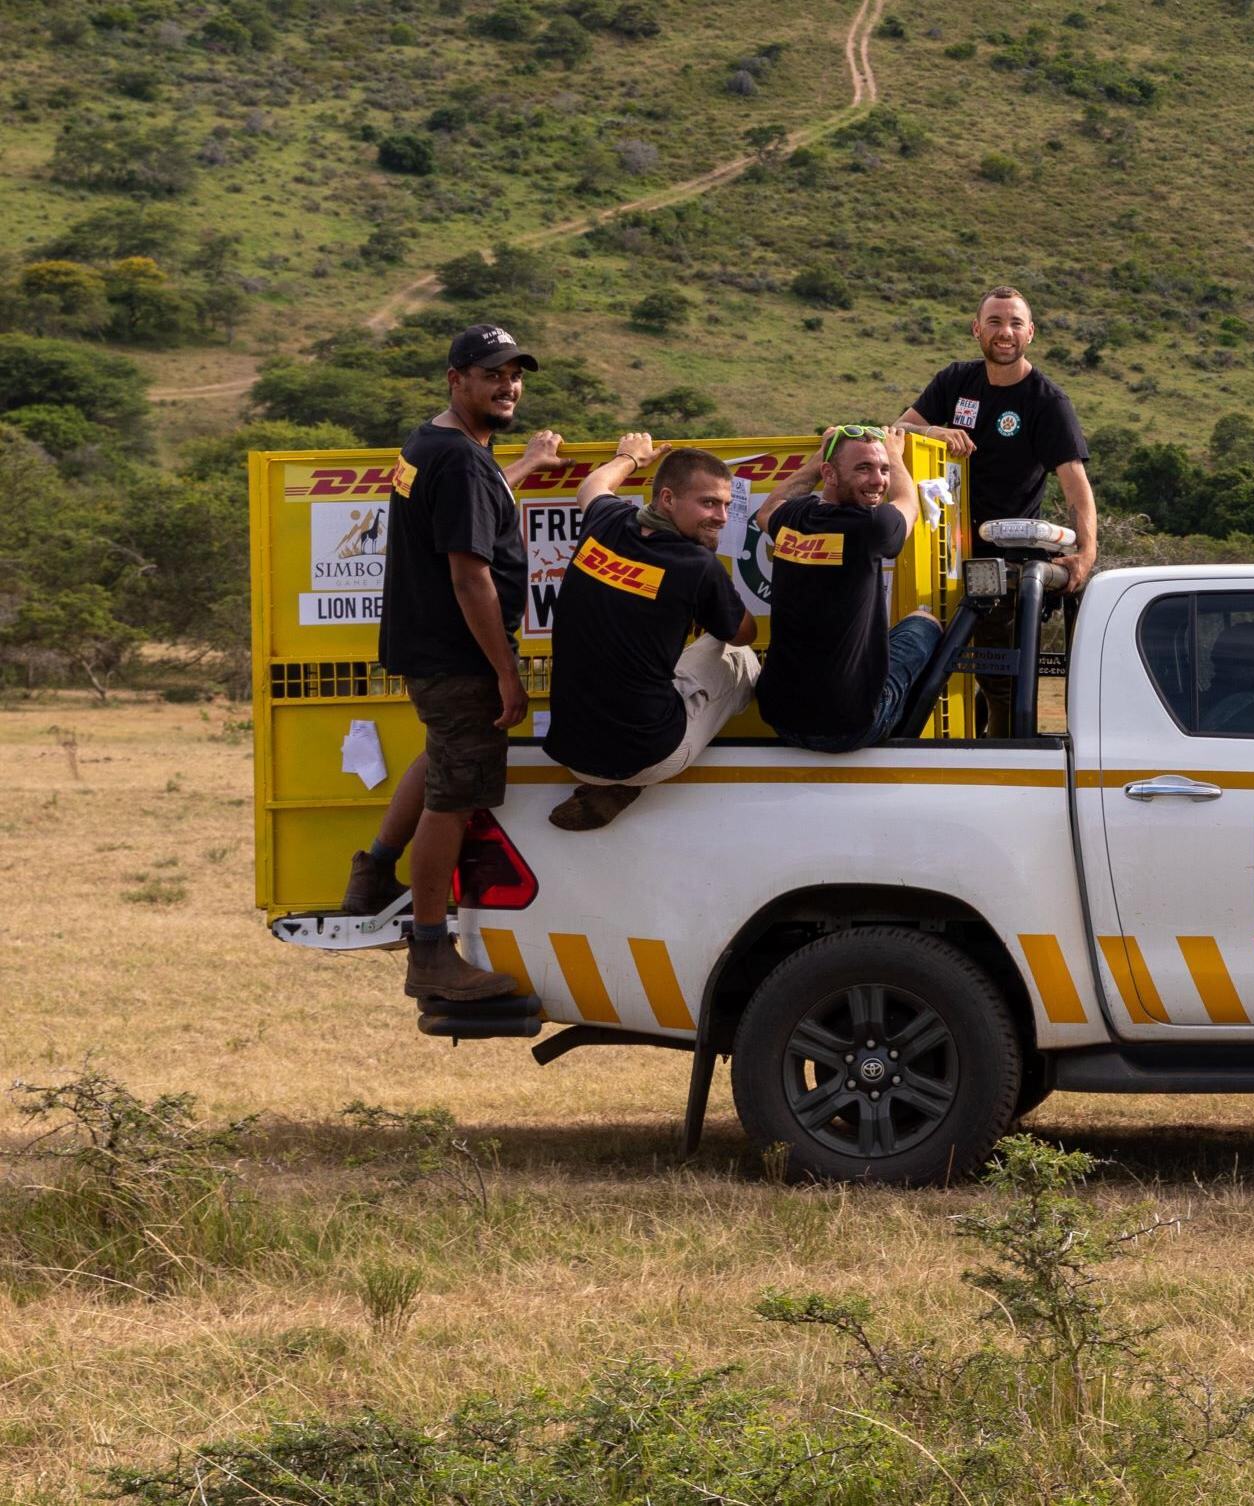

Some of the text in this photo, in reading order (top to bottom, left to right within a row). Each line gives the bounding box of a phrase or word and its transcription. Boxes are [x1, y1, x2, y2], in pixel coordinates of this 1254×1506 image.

[308, 468, 396, 495] DH
[529, 508, 583, 542] FRE
[779, 534, 829, 560] DHL
[315, 562, 384, 578] SIMBO
[582, 546, 645, 590] DHL
[318, 596, 384, 620] LION RE
